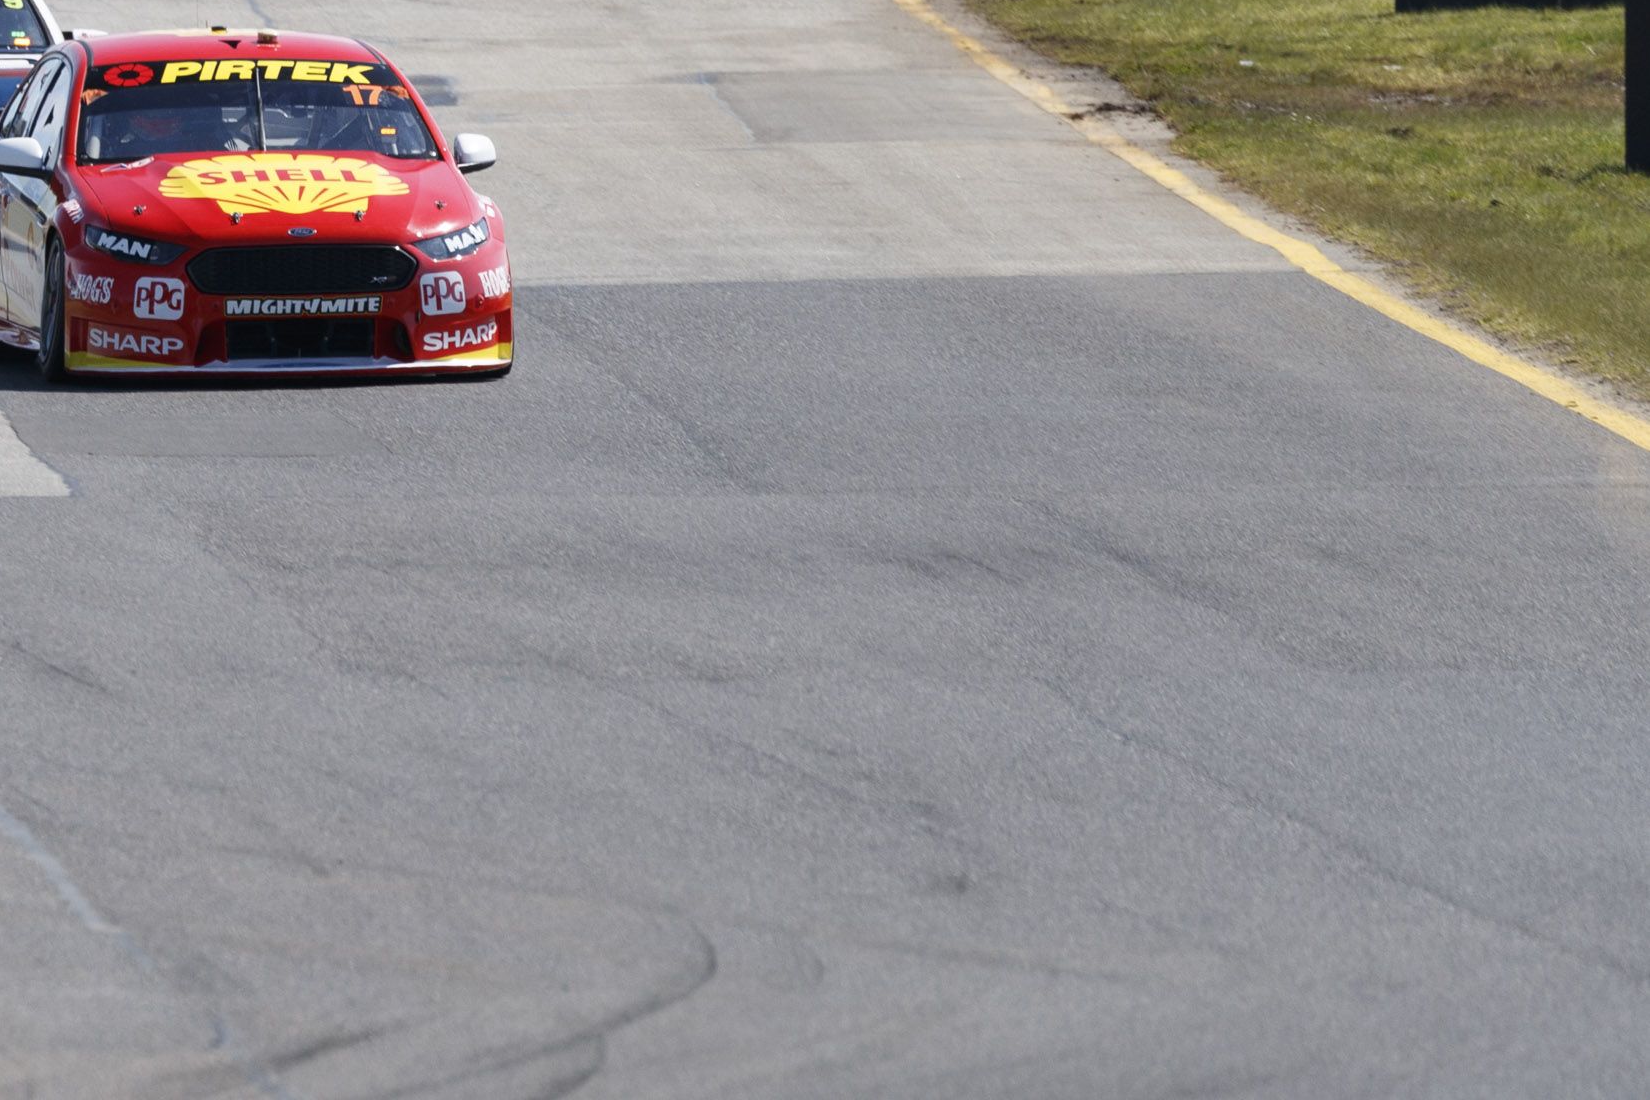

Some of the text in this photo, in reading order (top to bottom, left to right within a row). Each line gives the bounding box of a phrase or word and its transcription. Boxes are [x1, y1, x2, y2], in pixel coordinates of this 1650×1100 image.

[160, 60, 375, 85] PIRTEK
[342, 84, 384, 106] 17
[196, 168, 374, 185] SHELL
[97, 232, 152, 259] MAN
[444, 223, 486, 253] MAN
[136, 281, 183, 315] PPG
[422, 276, 464, 311] PPG
[88, 328, 184, 356] SHARP
[423, 321, 497, 352] SHARP
